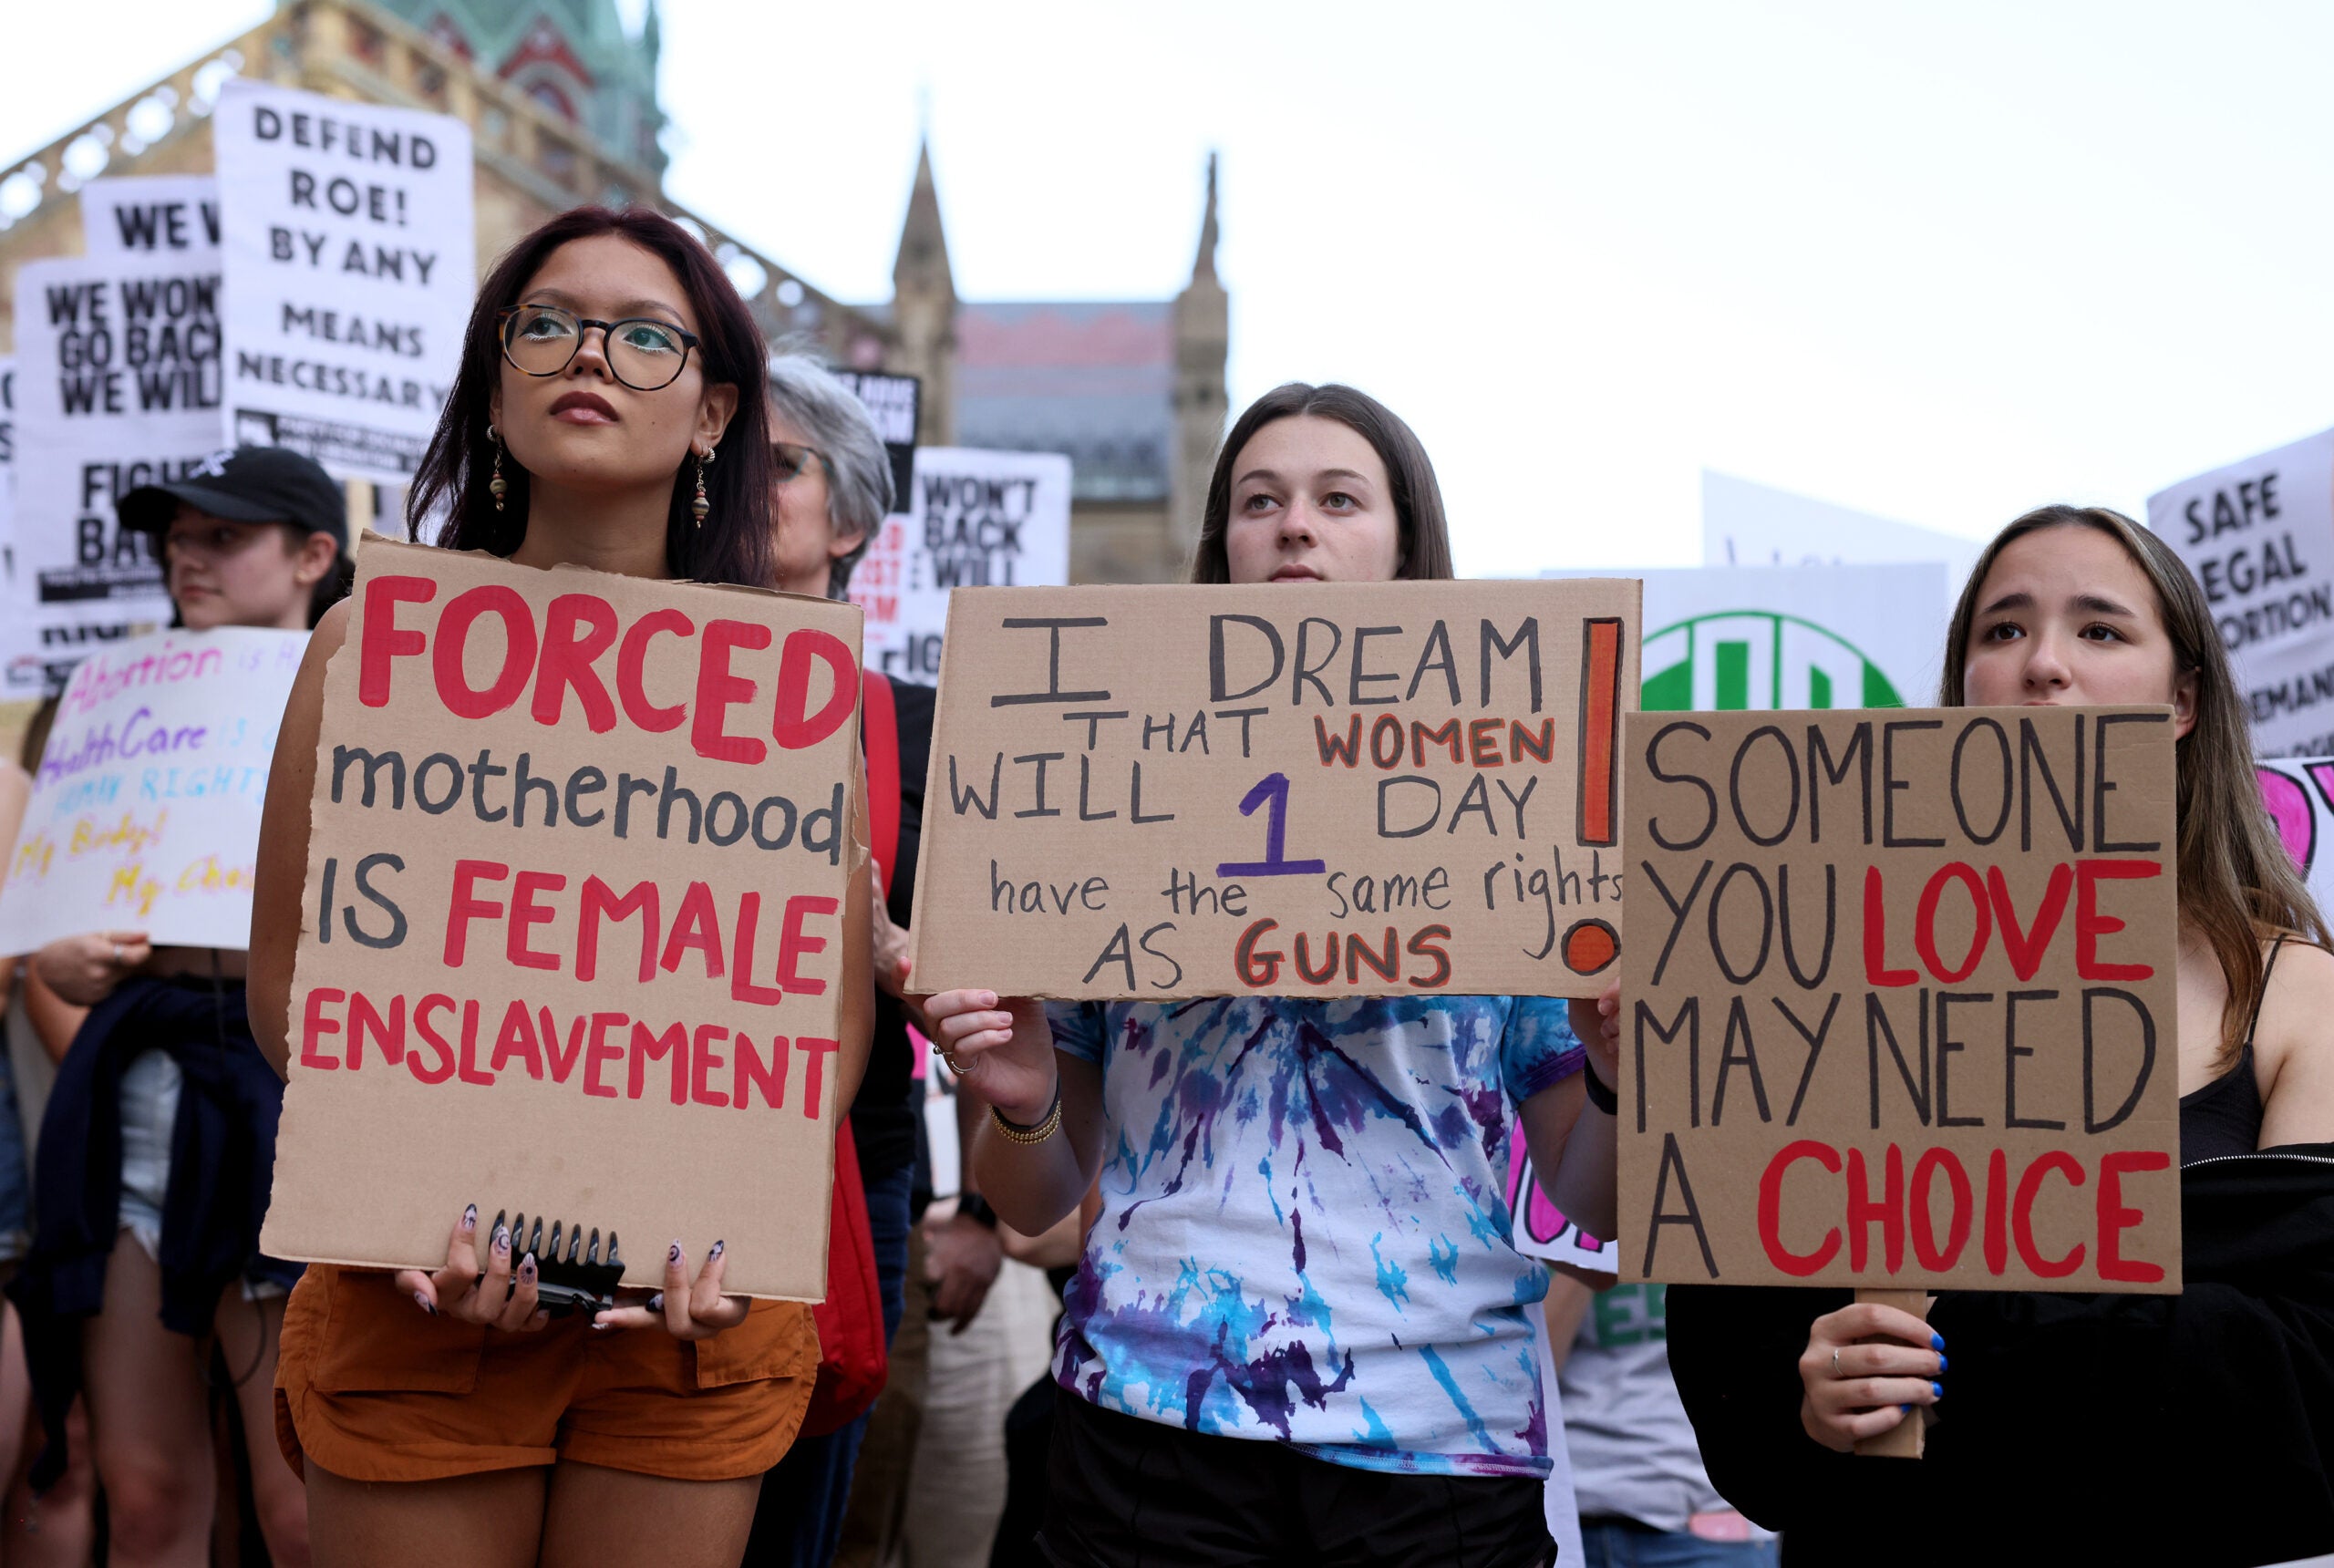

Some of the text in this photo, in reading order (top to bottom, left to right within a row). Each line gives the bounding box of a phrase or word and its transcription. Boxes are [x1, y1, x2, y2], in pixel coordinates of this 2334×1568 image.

[254, 106, 436, 170] DEFEND
[115, 202, 188, 249] WE
[290, 169, 407, 226] ROE!
[270, 226, 436, 285] BY ANY
[47, 282, 107, 325] WE
[281, 302, 424, 358] MEANS
[60, 326, 113, 368] GO
[61, 372, 124, 416] WE
[924, 515, 1022, 554] BACK
[2184, 472, 2280, 545] SAFE
[2200, 531, 2308, 603] EGAL
[2219, 585, 2331, 650] ORTION
[358, 575, 859, 765] FORCED
[991, 617, 1110, 707] I
[1210, 614, 1542, 714] DREAM
[1063, 707, 1554, 769] THAT WOMEN
[331, 744, 844, 865] motherhood
[949, 751, 1538, 877] WILL 1 DAY
[1646, 713, 2171, 853] SOMEONE
[319, 852, 839, 1006] IS FEMALE
[991, 845, 1623, 960] have the same rights
[1641, 859, 2162, 990] YOU LOVE
[1082, 917, 1451, 991] AS GUNS
[300, 988, 840, 1119] ENSLAVEMENT
[1635, 987, 2156, 1135] MAY NEED
[1642, 1132, 1720, 1279] A
[1757, 1140, 2171, 1283] CHOICE
